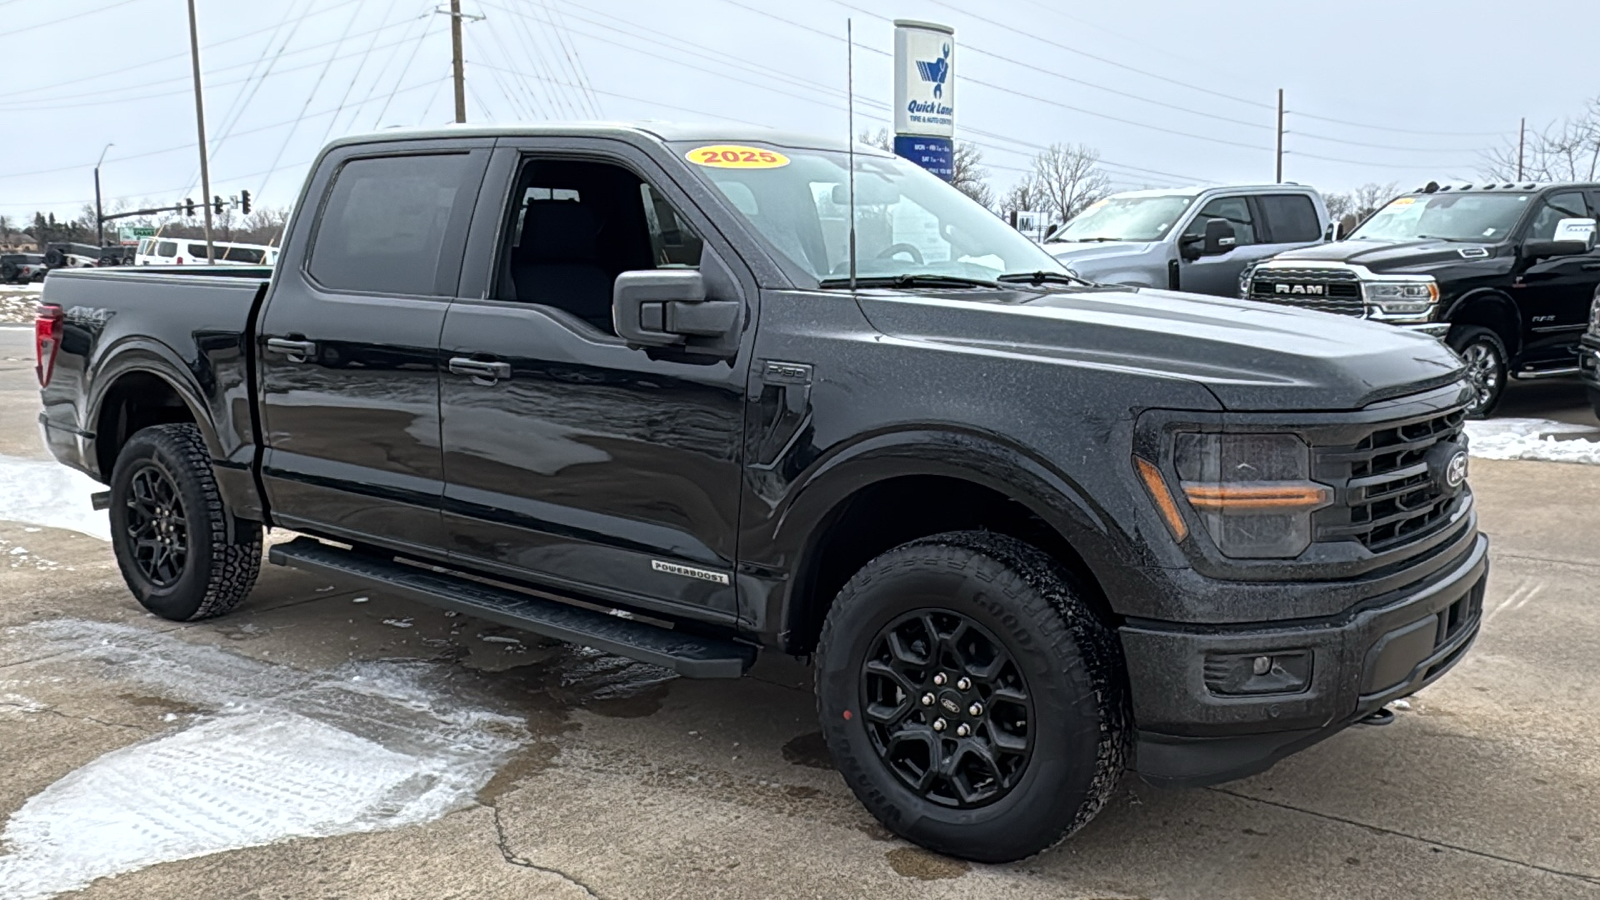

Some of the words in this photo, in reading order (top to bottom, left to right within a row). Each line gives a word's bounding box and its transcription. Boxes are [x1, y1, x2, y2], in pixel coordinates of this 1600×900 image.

[907, 100, 936, 114] Quick
[936, 103, 952, 116] Lane
[910, 115, 921, 123] TIRE
[701, 151, 778, 163] 2025
[1275, 284, 1323, 294] RAM
[655, 562, 724, 583] POWERBOOST
